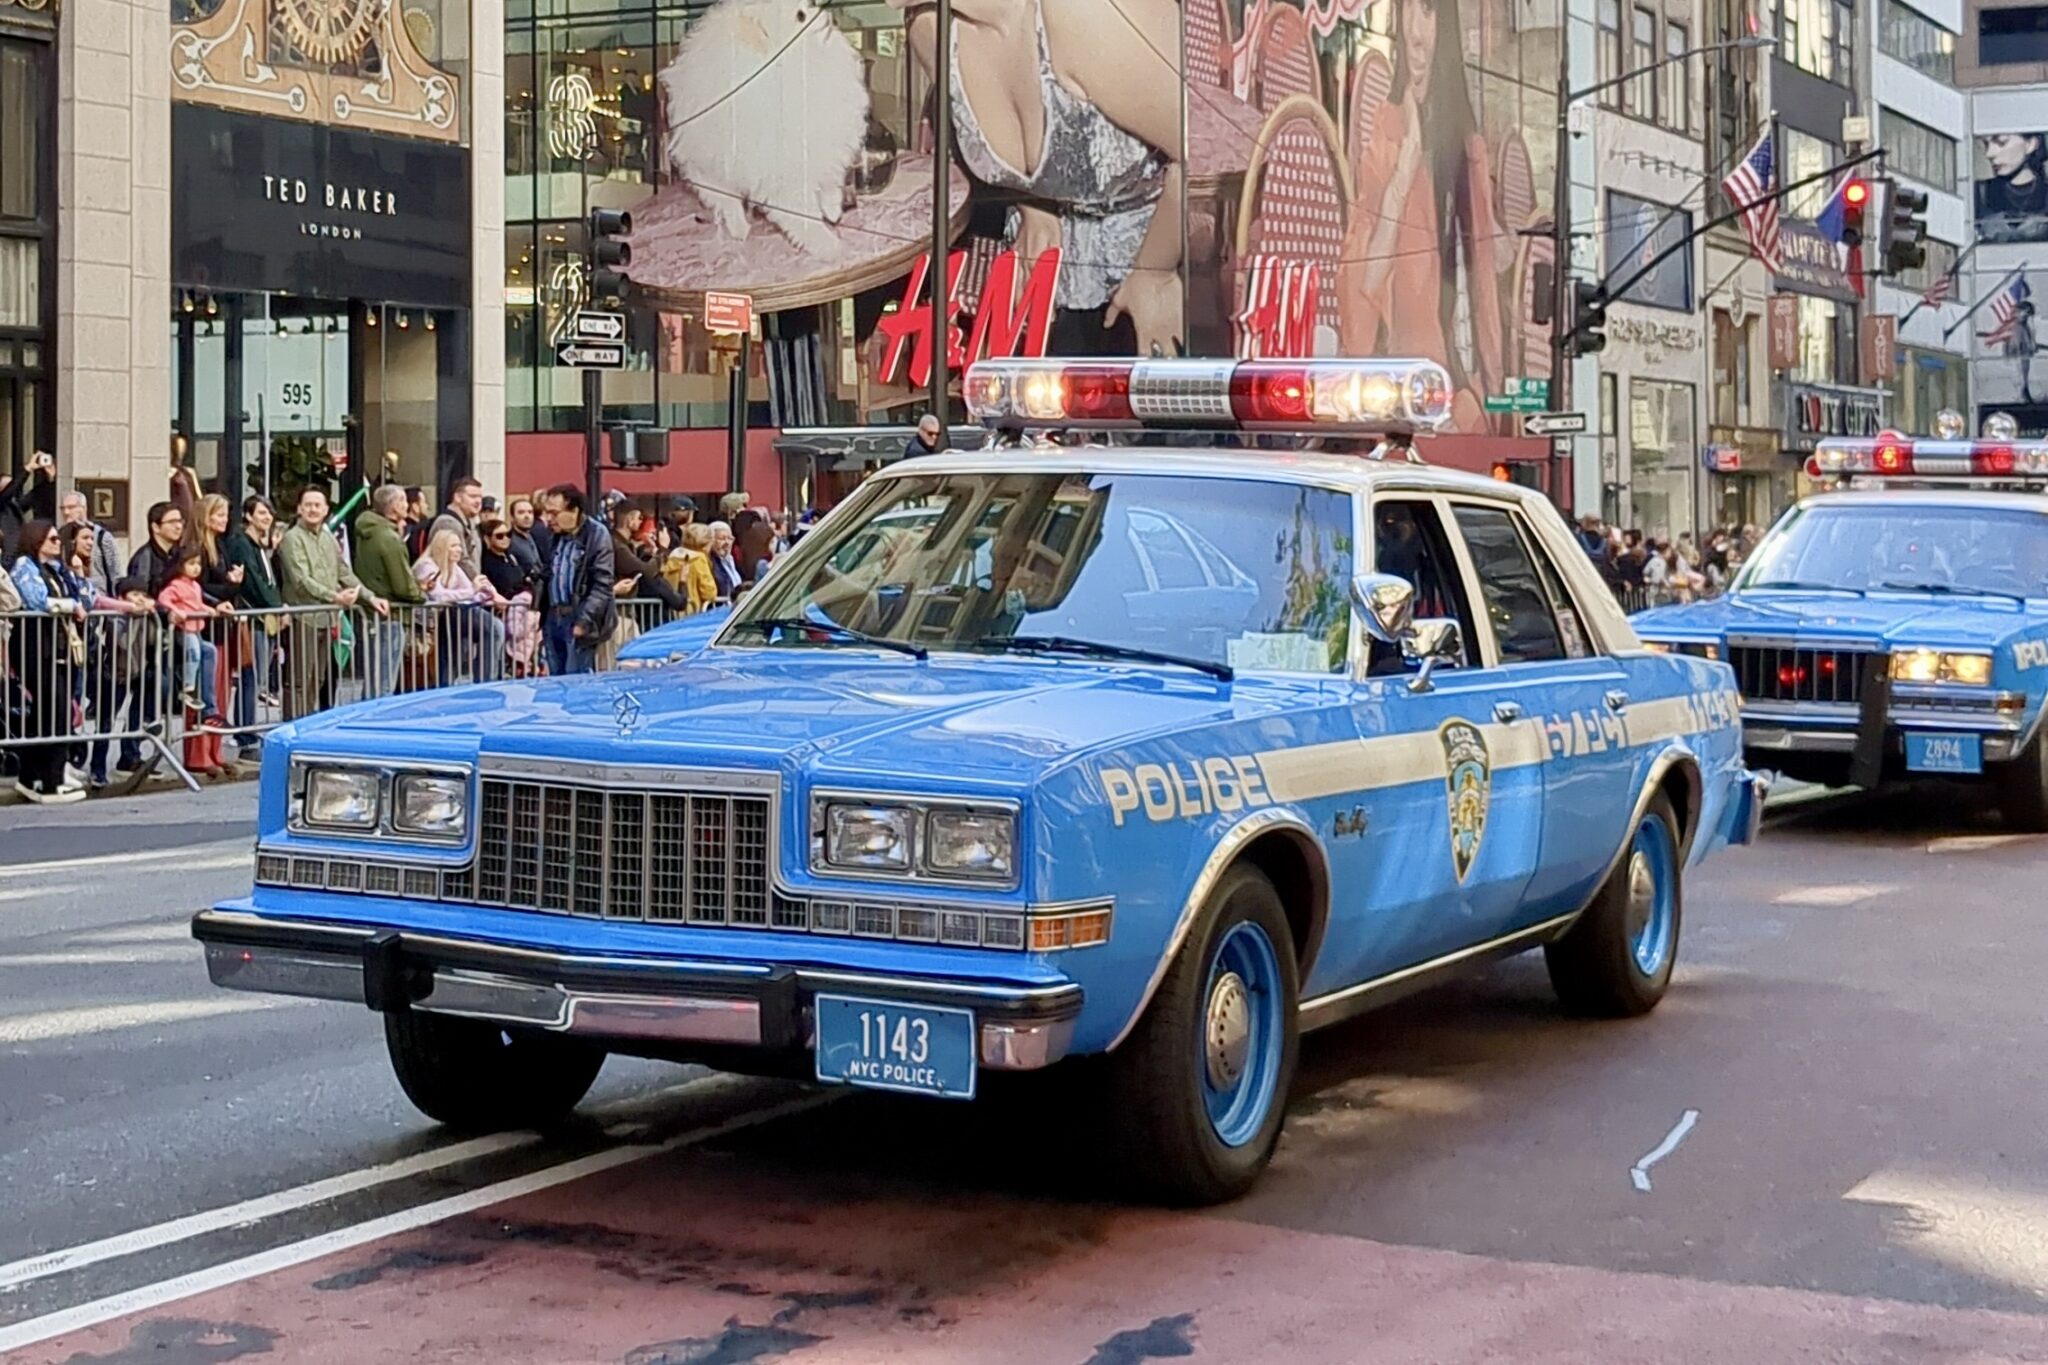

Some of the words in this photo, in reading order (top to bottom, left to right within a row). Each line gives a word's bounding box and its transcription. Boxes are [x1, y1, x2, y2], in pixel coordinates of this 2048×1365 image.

[264, 175, 306, 203] TED
[325, 184, 396, 215] BAKER
[301, 223, 361, 240] LONDON
[583, 321, 598, 331] ONE
[603, 323, 617, 332] WAY
[565, 350, 584, 360] ONE
[594, 352, 615, 360] WAY
[283, 383, 312, 406] 595
[1100, 755, 1272, 826] POLICE
[860, 1012, 929, 1063] 1143
[850, 1061, 880, 1079] NYC
[884, 1064, 936, 1085] POLICE
